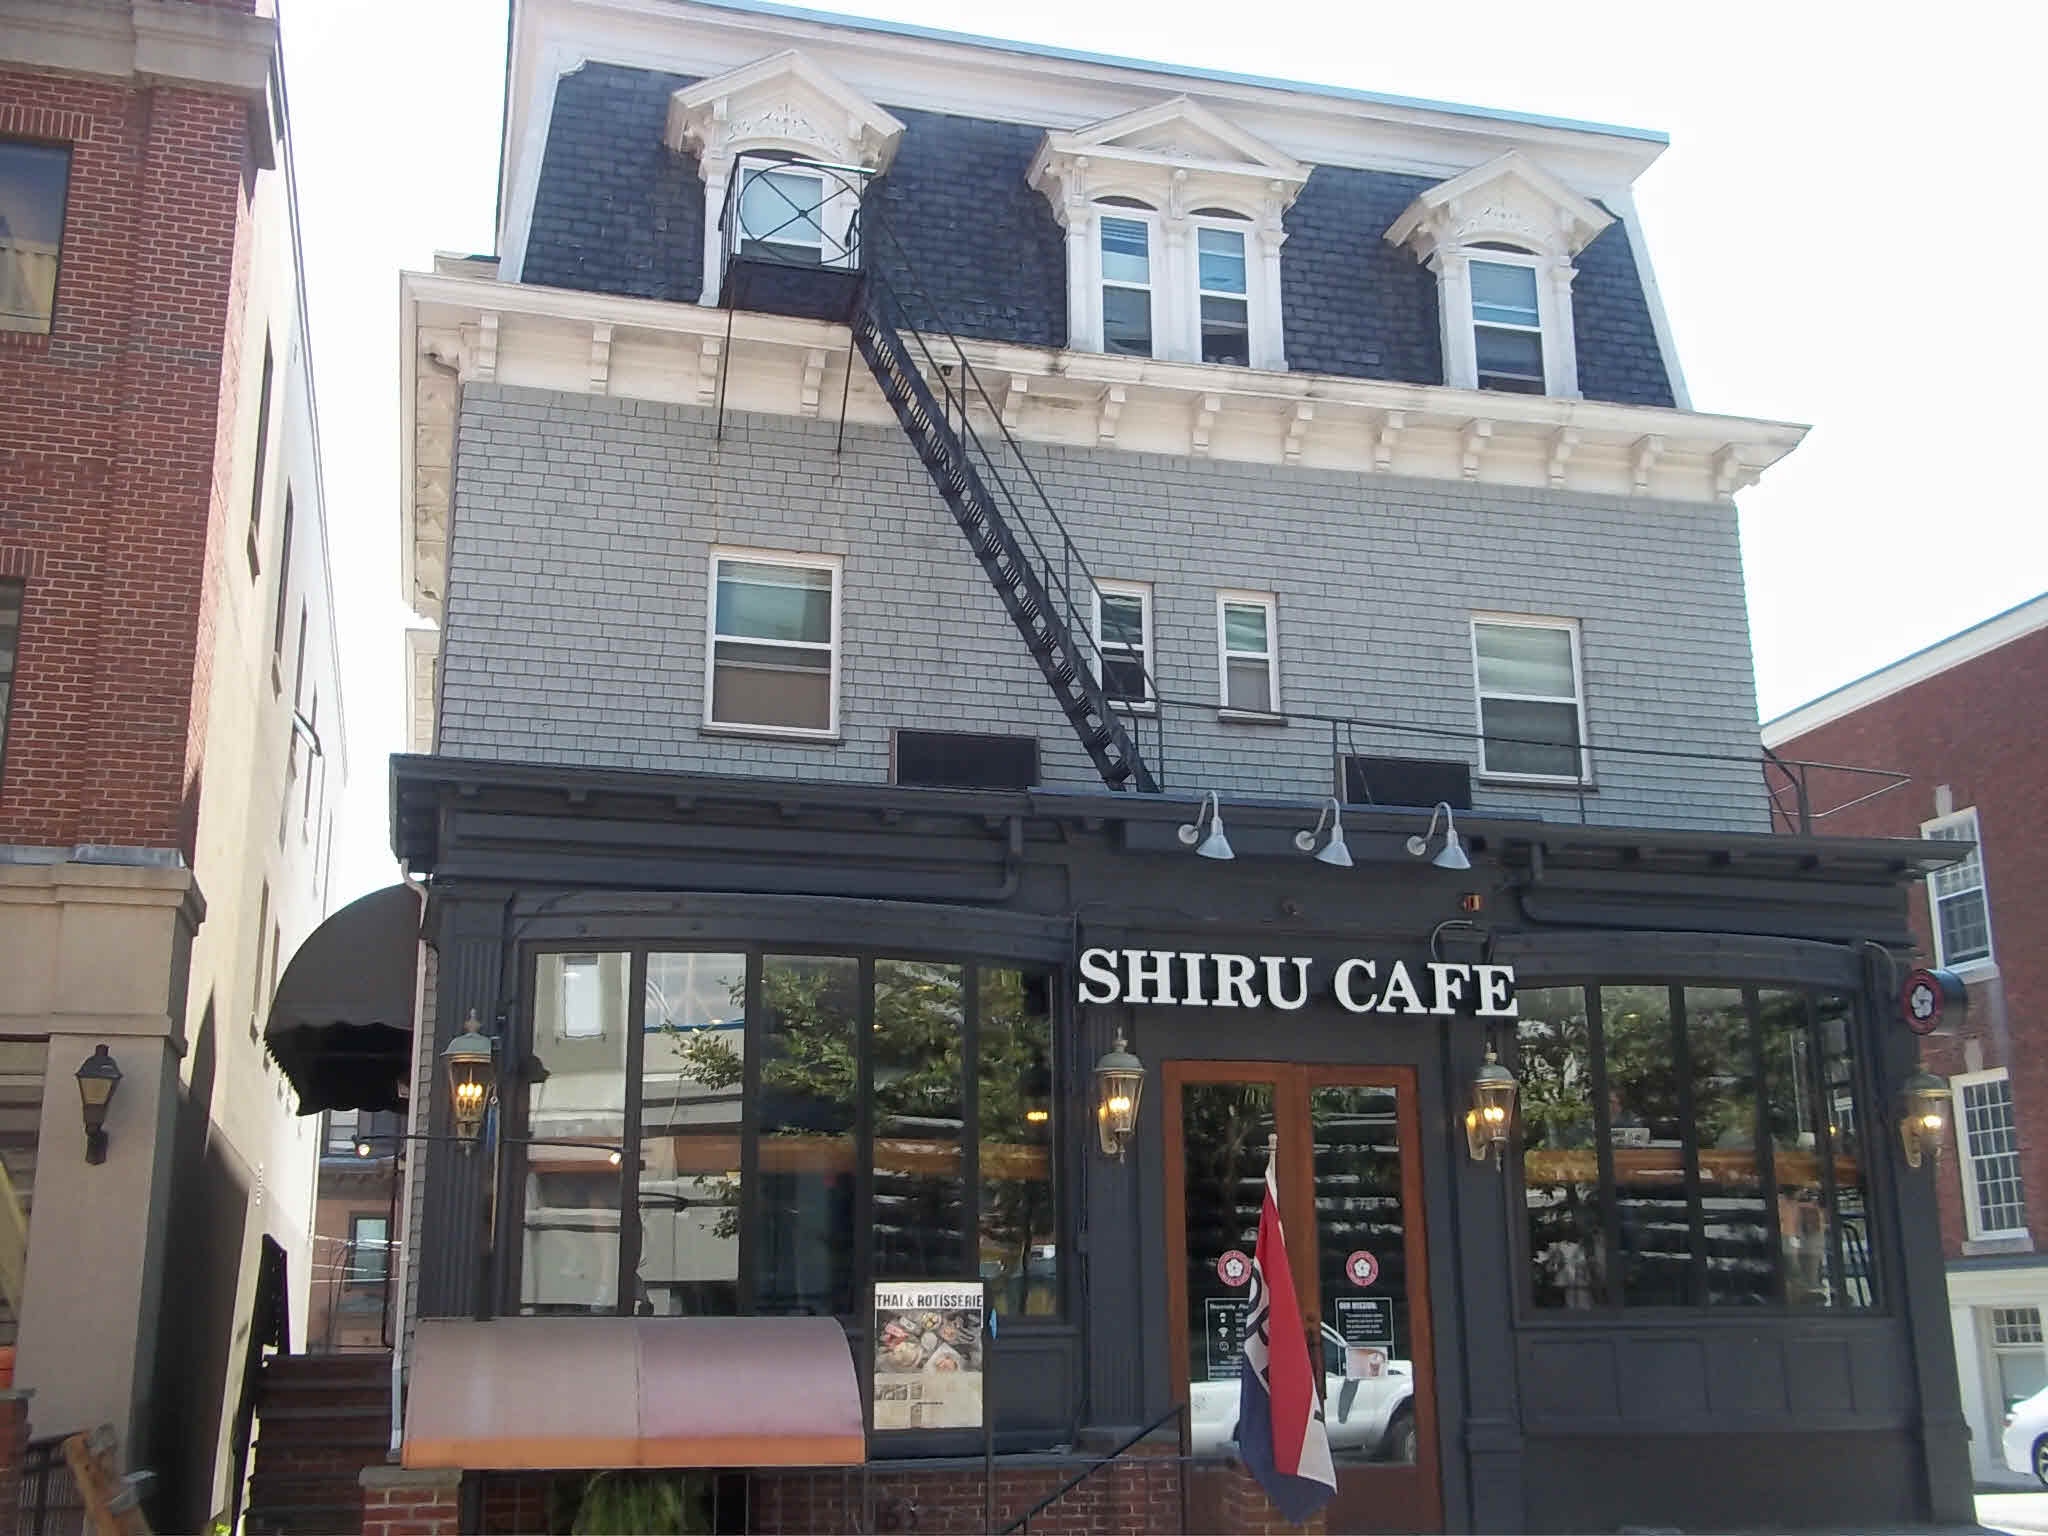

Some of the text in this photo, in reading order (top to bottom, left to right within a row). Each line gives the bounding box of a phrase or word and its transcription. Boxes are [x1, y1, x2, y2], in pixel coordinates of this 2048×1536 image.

[1079, 948, 1518, 1016] SHIRU CAFE
[876, 1294, 983, 1307] THAI & ROTISSERIE
